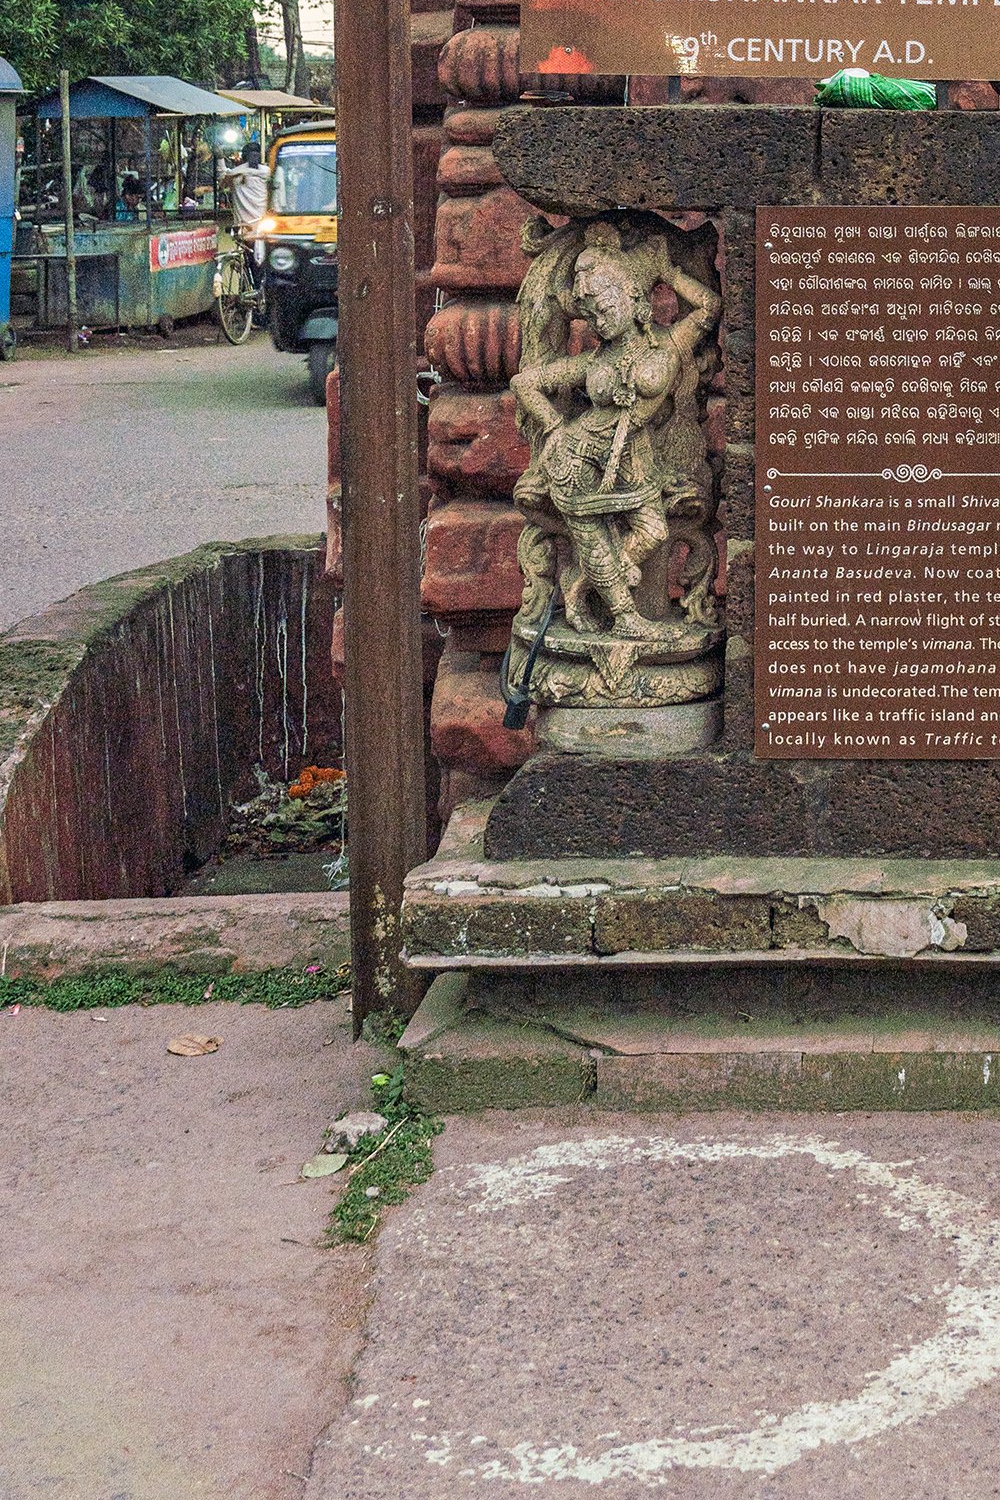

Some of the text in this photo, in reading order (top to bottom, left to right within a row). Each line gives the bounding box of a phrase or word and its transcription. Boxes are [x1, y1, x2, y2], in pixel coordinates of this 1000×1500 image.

[727, 38, 864, 62] CENTURY
[873, 40, 933, 63] A.D.
[769, 222, 827, 244] ବିନ୍ଦୁସାଗର
[833, 225, 861, 243] ମୁଖ୍ୟ
[867, 226, 898, 240] ରାସ୍ତା
[827, 251, 876, 264] କୋଣରେ
[880, 251, 903, 264] ଏକ
[769, 277, 793, 292] ଏହା
[798, 274, 868, 291] ଗୌରୀଶଙ୍କର
[872, 277, 914, 291] ନାମରେ
[919, 274, 954, 290] ନାମିତ
[768, 299, 814, 316] ମନ୍ଦିରର
[886, 303, 922, 321] ଅଧୁନା
[768, 325, 802, 343] ରହିଛି
[817, 329, 839, 342] ଏକ
[891, 328, 929, 343] ପାହାଚ
[934, 325, 979, 342] ମନ୍ଦିରର
[818, 354, 862, 368] ଏଠାରେ
[868, 354, 932, 369] ଜଗମୋହନ
[971, 354, 999, 367] ଏବଂ
[769, 380, 796, 394] ମଧ୍ୟ
[801, 377, 844, 394] କୌଣସି
[850, 377, 895, 399] କଳାକୃତି
[901, 377, 955, 398] ଦେଖିବାକୁ
[959, 377, 988, 393] ମିଳେ
[768, 403, 812, 420] ମନ୍ଦିରଟି
[817, 406, 840, 419] ଏକ
[845, 406, 875, 421] ରାସ୍ତା
[880, 403, 920, 420] ମଝିରେ
[926, 403, 983, 424] ରହିଥିବାରୁ
[769, 428, 798, 447] କେହି
[846, 428, 879, 446] ମନ୍ଦିର
[884, 428, 917, 446] ବୋଲି
[921, 432, 949, 445] ମଧ୍ୟ
[769, 495, 812, 509] Gouri
[815, 494, 885, 509] Shankara
[888, 495, 900, 508] is
[904, 498, 913, 508] a
[917, 494, 956, 509] small
[961, 494, 1000, 509] Shiva
[768, 518, 805, 532] built
[808, 521, 829, 532] on
[833, 518, 859, 532] the
[863, 518, 901, 532] main
[906, 518, 993, 535] Bindusagar
[767, 542, 796, 556] the
[801, 545, 835, 559] way
[841, 543, 859, 556] to
[865, 542, 945, 559] Lingaraja
[768, 566, 829, 580] Ananta
[835, 565, 917, 580] Basudeva.
[924, 566, 960, 579] Now
[768, 589, 830, 606] painted
[835, 589, 850, 603] in
[856, 589, 882, 603] red
[888, 589, 948, 606] plaster,
[953, 589, 981, 603] the
[768, 612, 797, 627] half
[800, 612, 851, 627] buried.
[855, 613, 867, 627] A
[870, 616, 923, 627] narrow
[925, 612, 966, 630] flight
[968, 612, 985, 627] of
[768, 639, 810, 651] access
[812, 638, 829, 651] to
[831, 637, 856, 651] the
[922, 637, 976, 651] vimana.
[767, 660, 807, 675] does
[813, 662, 841, 674] not
[847, 660, 887, 675] have
[892, 660, 997, 678] jagamohana
[769, 684, 823, 698] vimana
[826, 684, 838, 698] is
[768, 710, 828, 725] appears
[832, 708, 860, 722] like
[864, 711, 874, 722] a
[878, 707, 926, 722] traffic
[931, 708, 975, 722] island
[768, 731, 827, 749] locally
[833, 732, 891, 746] known
[898, 735, 916, 746] as
[924, 731, 983, 746] Traffic
